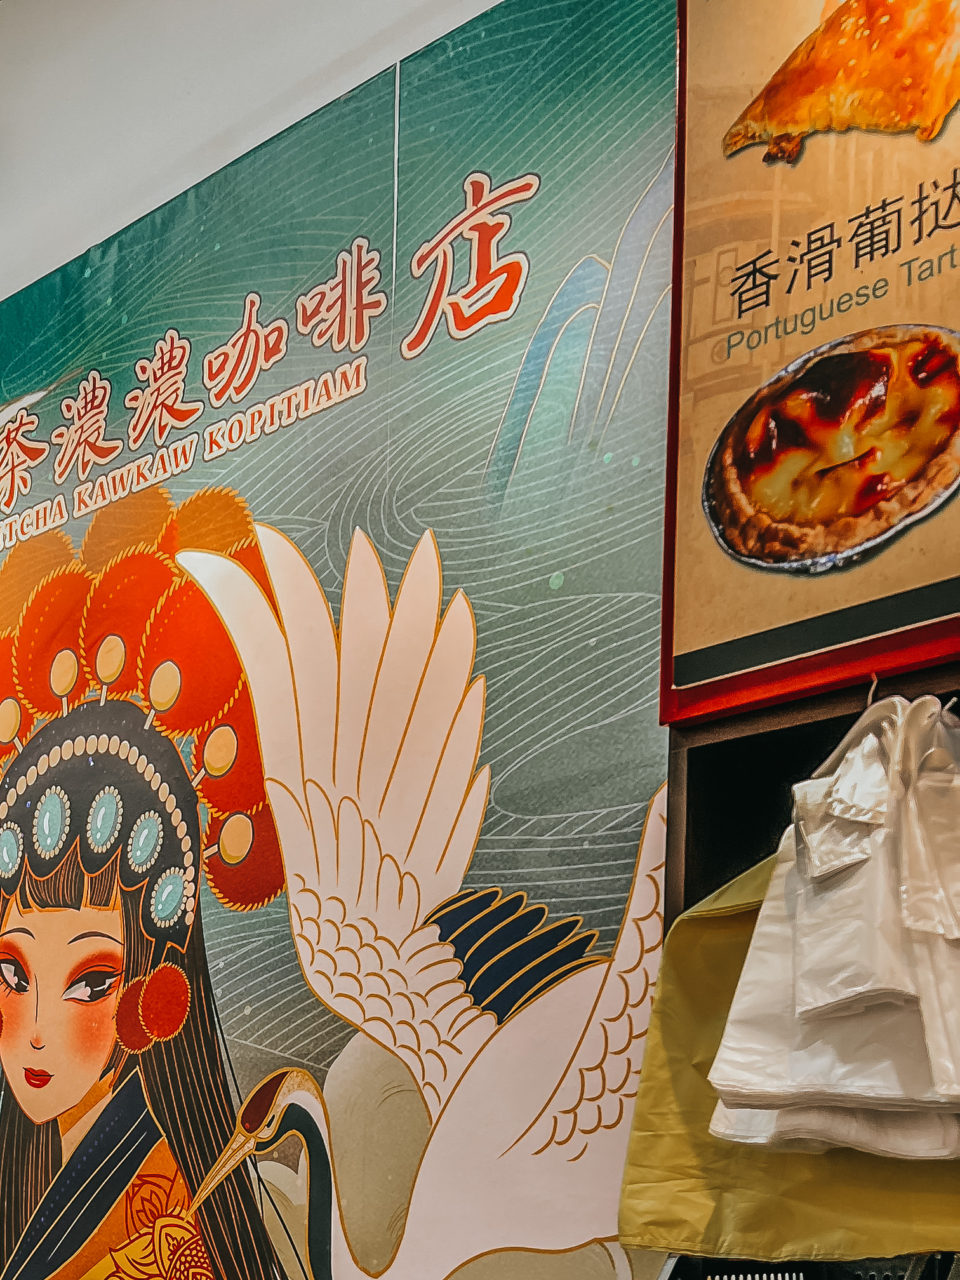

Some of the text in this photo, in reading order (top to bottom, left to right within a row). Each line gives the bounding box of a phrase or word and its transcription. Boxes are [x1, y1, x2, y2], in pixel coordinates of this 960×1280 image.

[726, 244, 958, 359] Portuguese Tart
[730, 168, 960, 319] 香滑葡挞
[74, 436, 198, 517] KAWKAW
[205, 358, 367, 460] KOPITIAM
